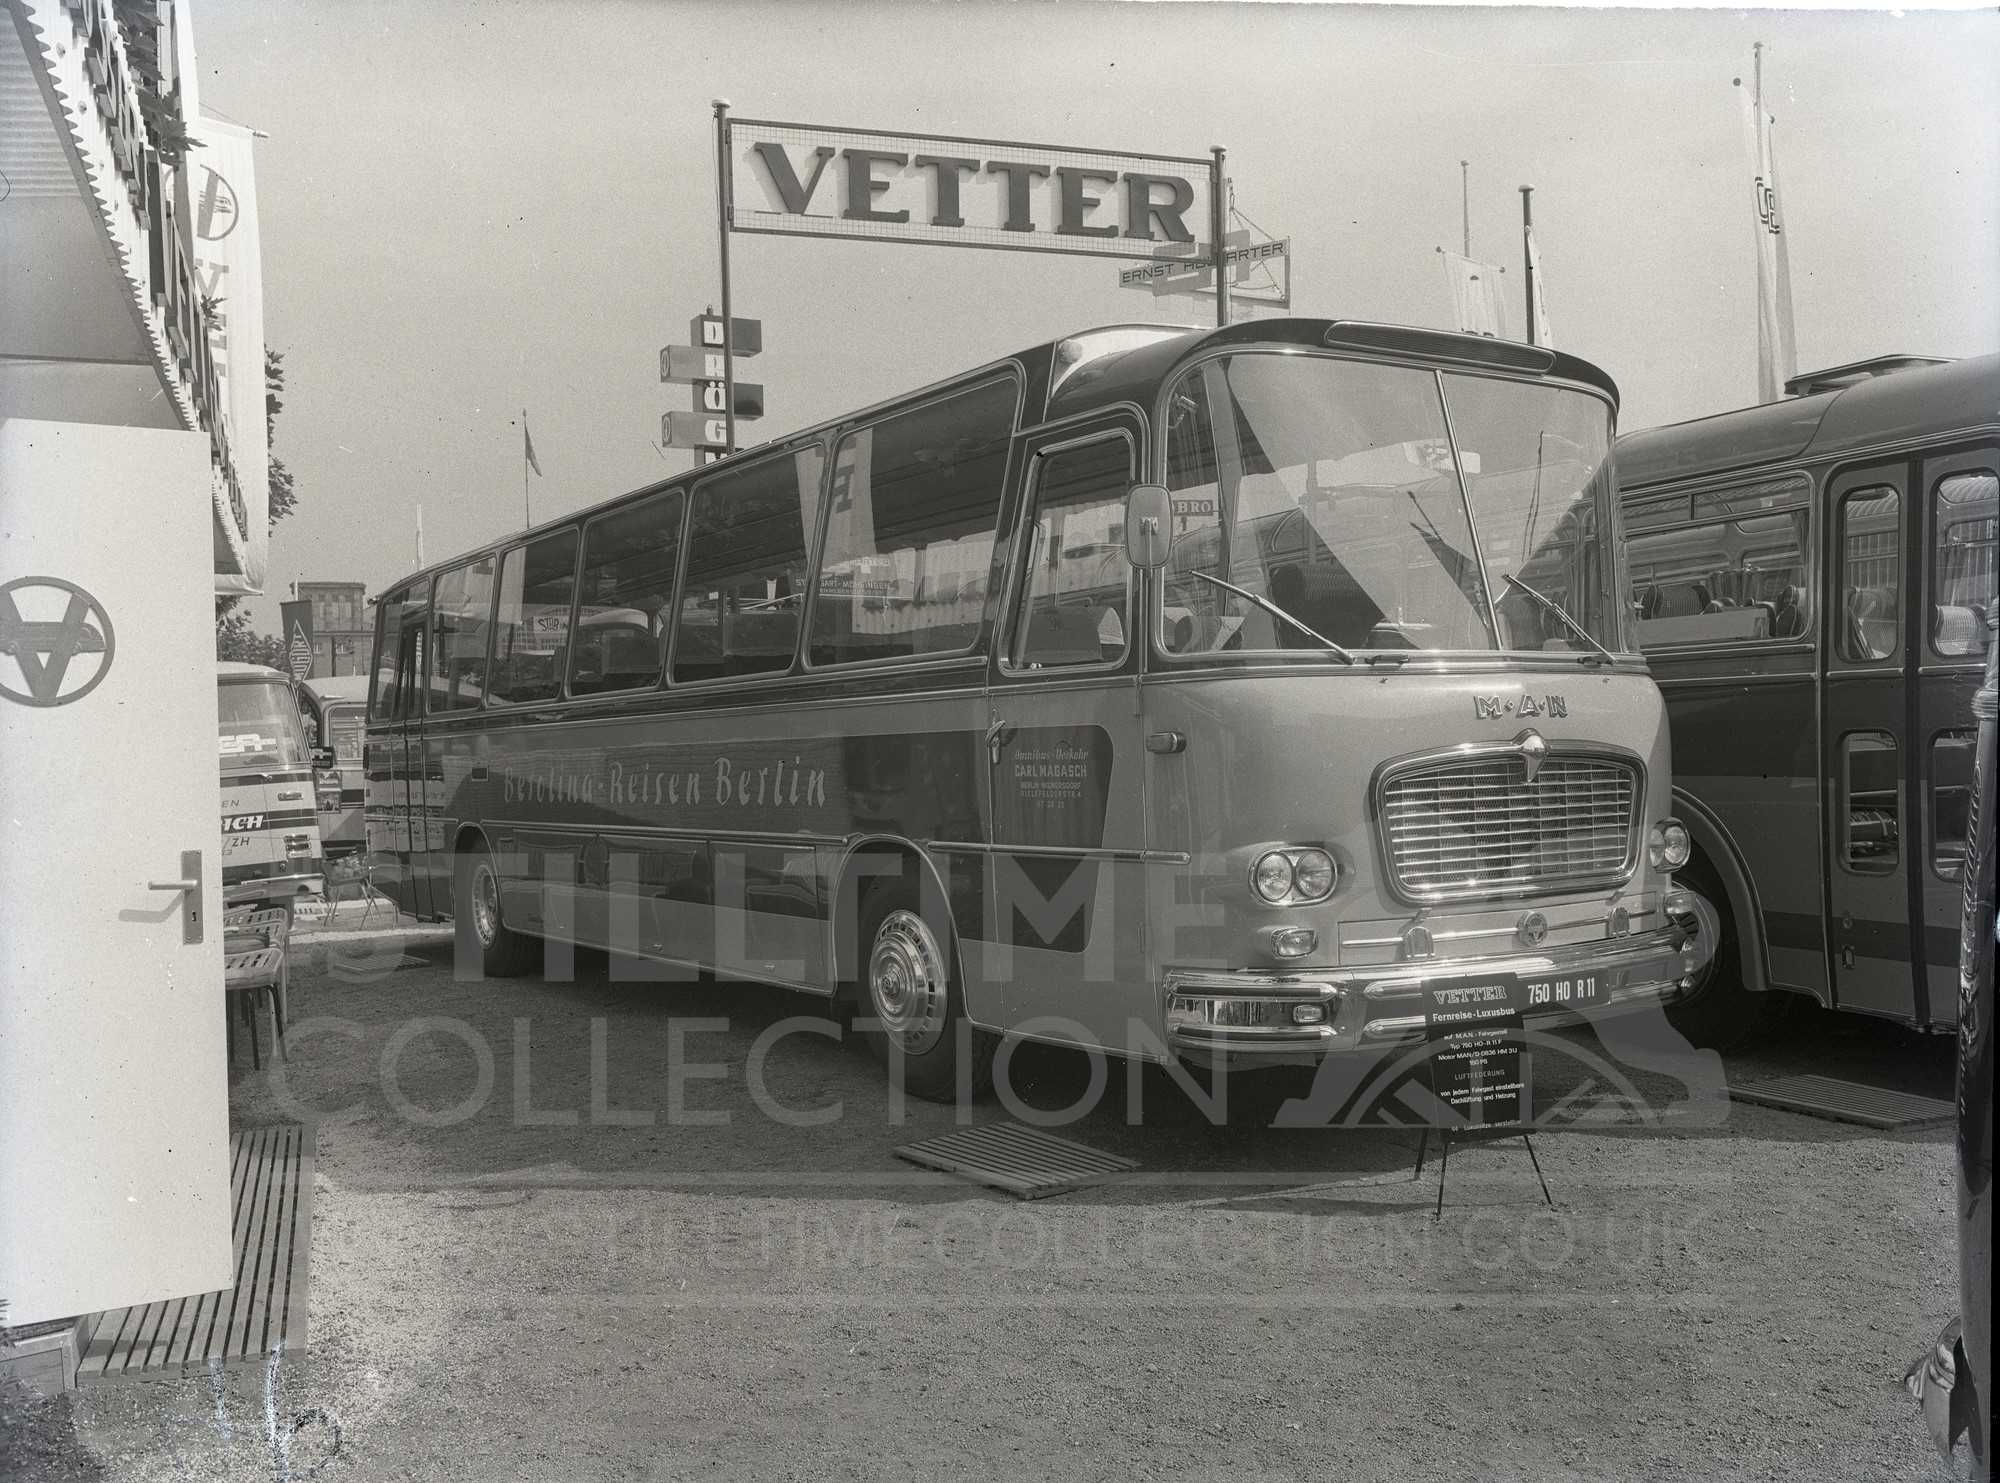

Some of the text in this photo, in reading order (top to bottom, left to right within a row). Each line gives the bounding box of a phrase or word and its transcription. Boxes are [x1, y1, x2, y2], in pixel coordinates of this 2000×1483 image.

[754, 142, 1195, 243] VETTER
[1122, 262, 1175, 283] ERNST
[1015, 764, 1039, 777] CARL
[713, 755, 826, 808] Berlin
[1433, 985, 1507, 1005] VETTER
[1527, 983, 1550, 1005] 750
[1438, 1053, 1456, 1061] Motor
[1454, 1069, 1505, 1081] LUFTFEDERUNG
[1452, 1088, 1470, 1097] jedem
